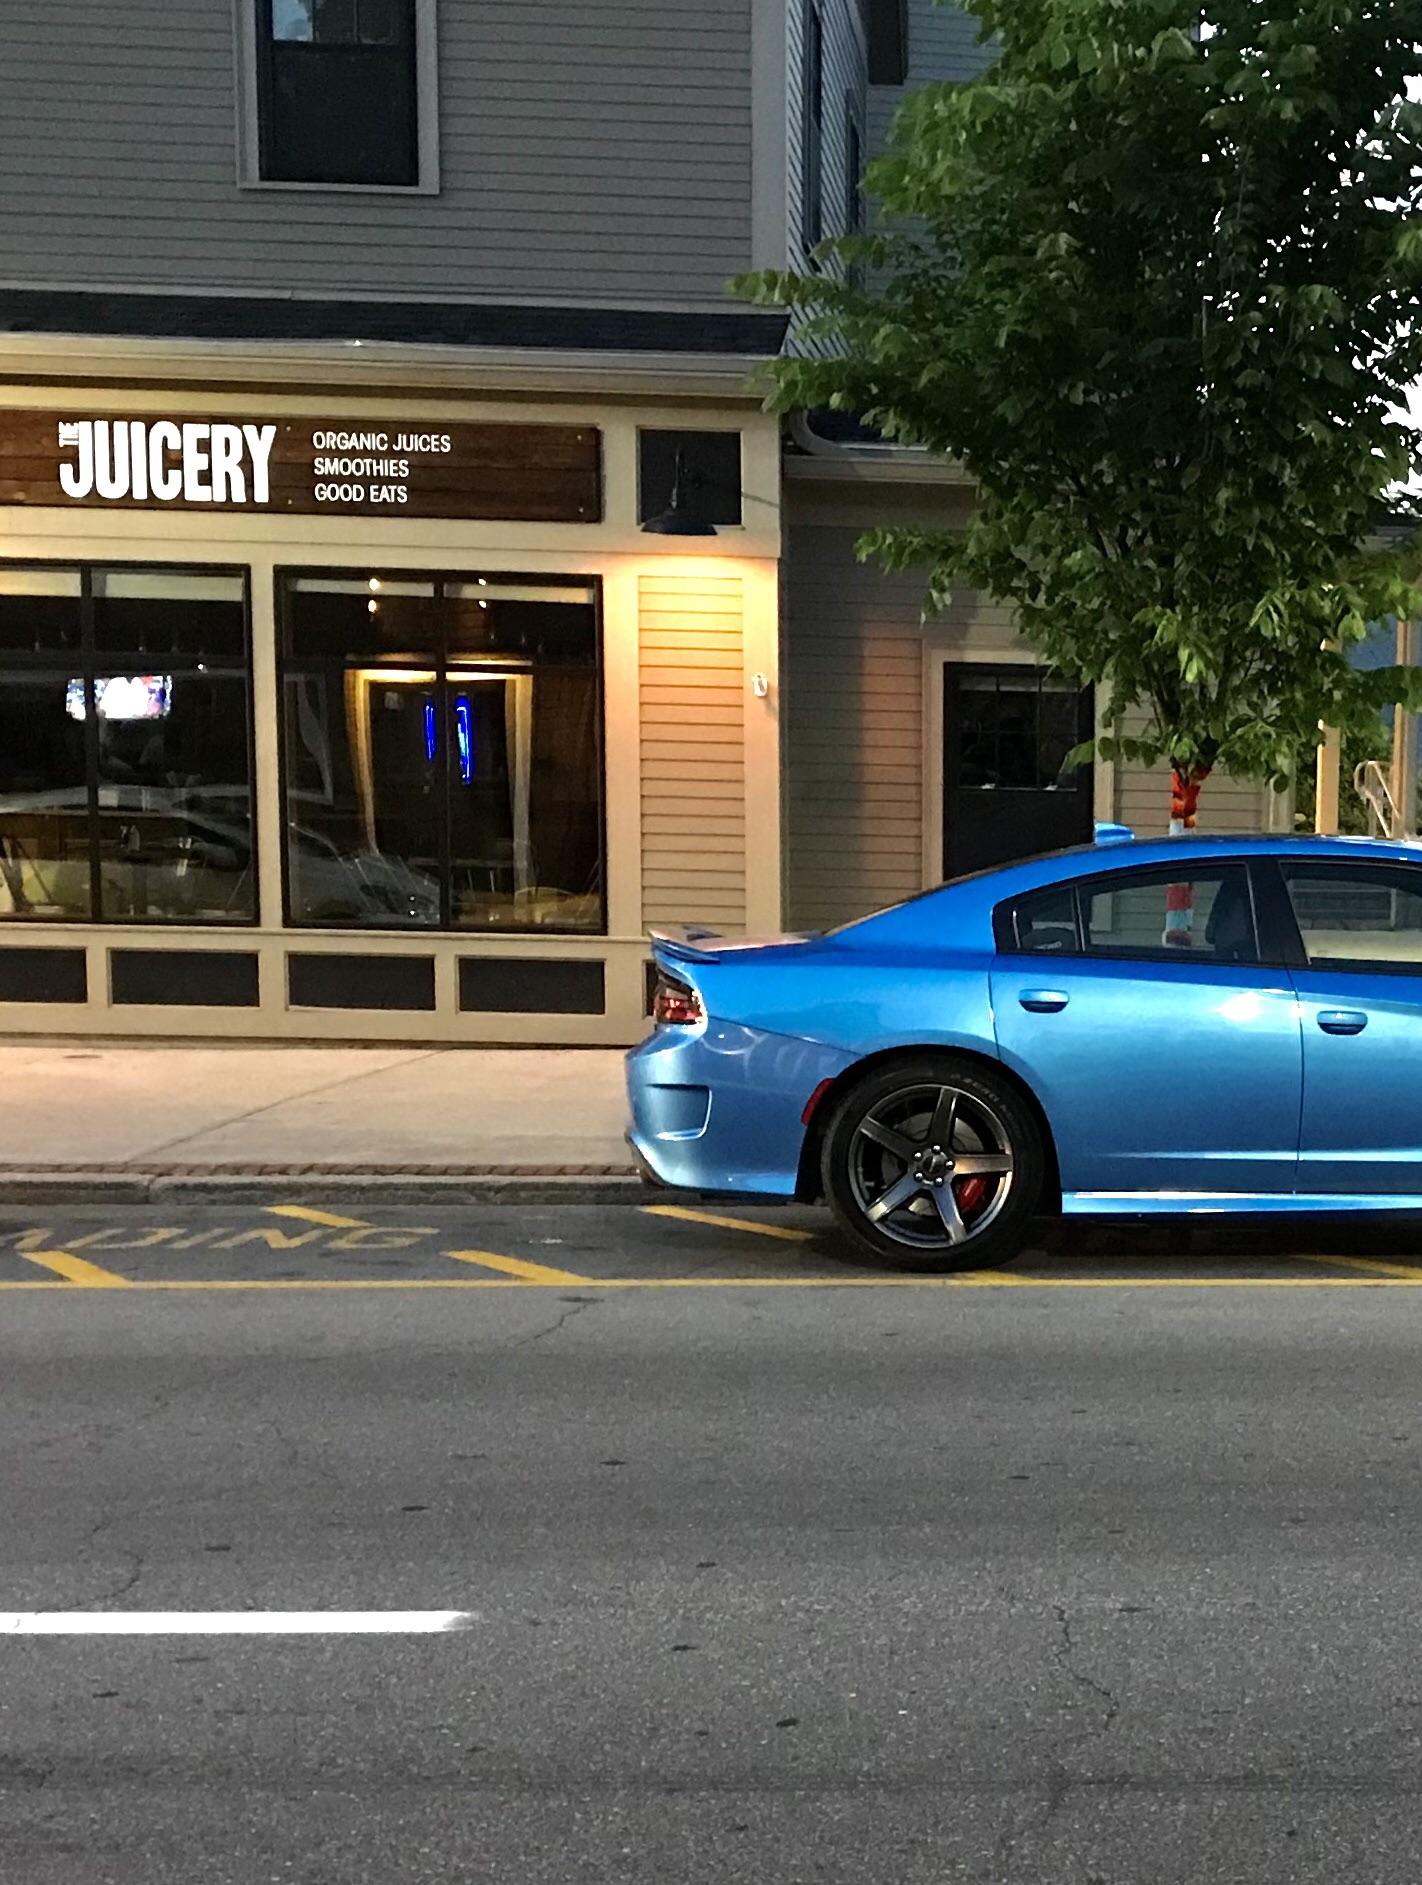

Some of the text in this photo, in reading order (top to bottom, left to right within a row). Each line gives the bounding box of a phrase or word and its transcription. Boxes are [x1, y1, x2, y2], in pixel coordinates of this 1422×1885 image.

[58, 421, 79, 447] THE
[312, 431, 451, 453] ORGANIC JUICES
[59, 420, 277, 503] JUICERY
[313, 457, 410, 477] SMOOTHIES
[314, 483, 408, 503] GOOD EATS
